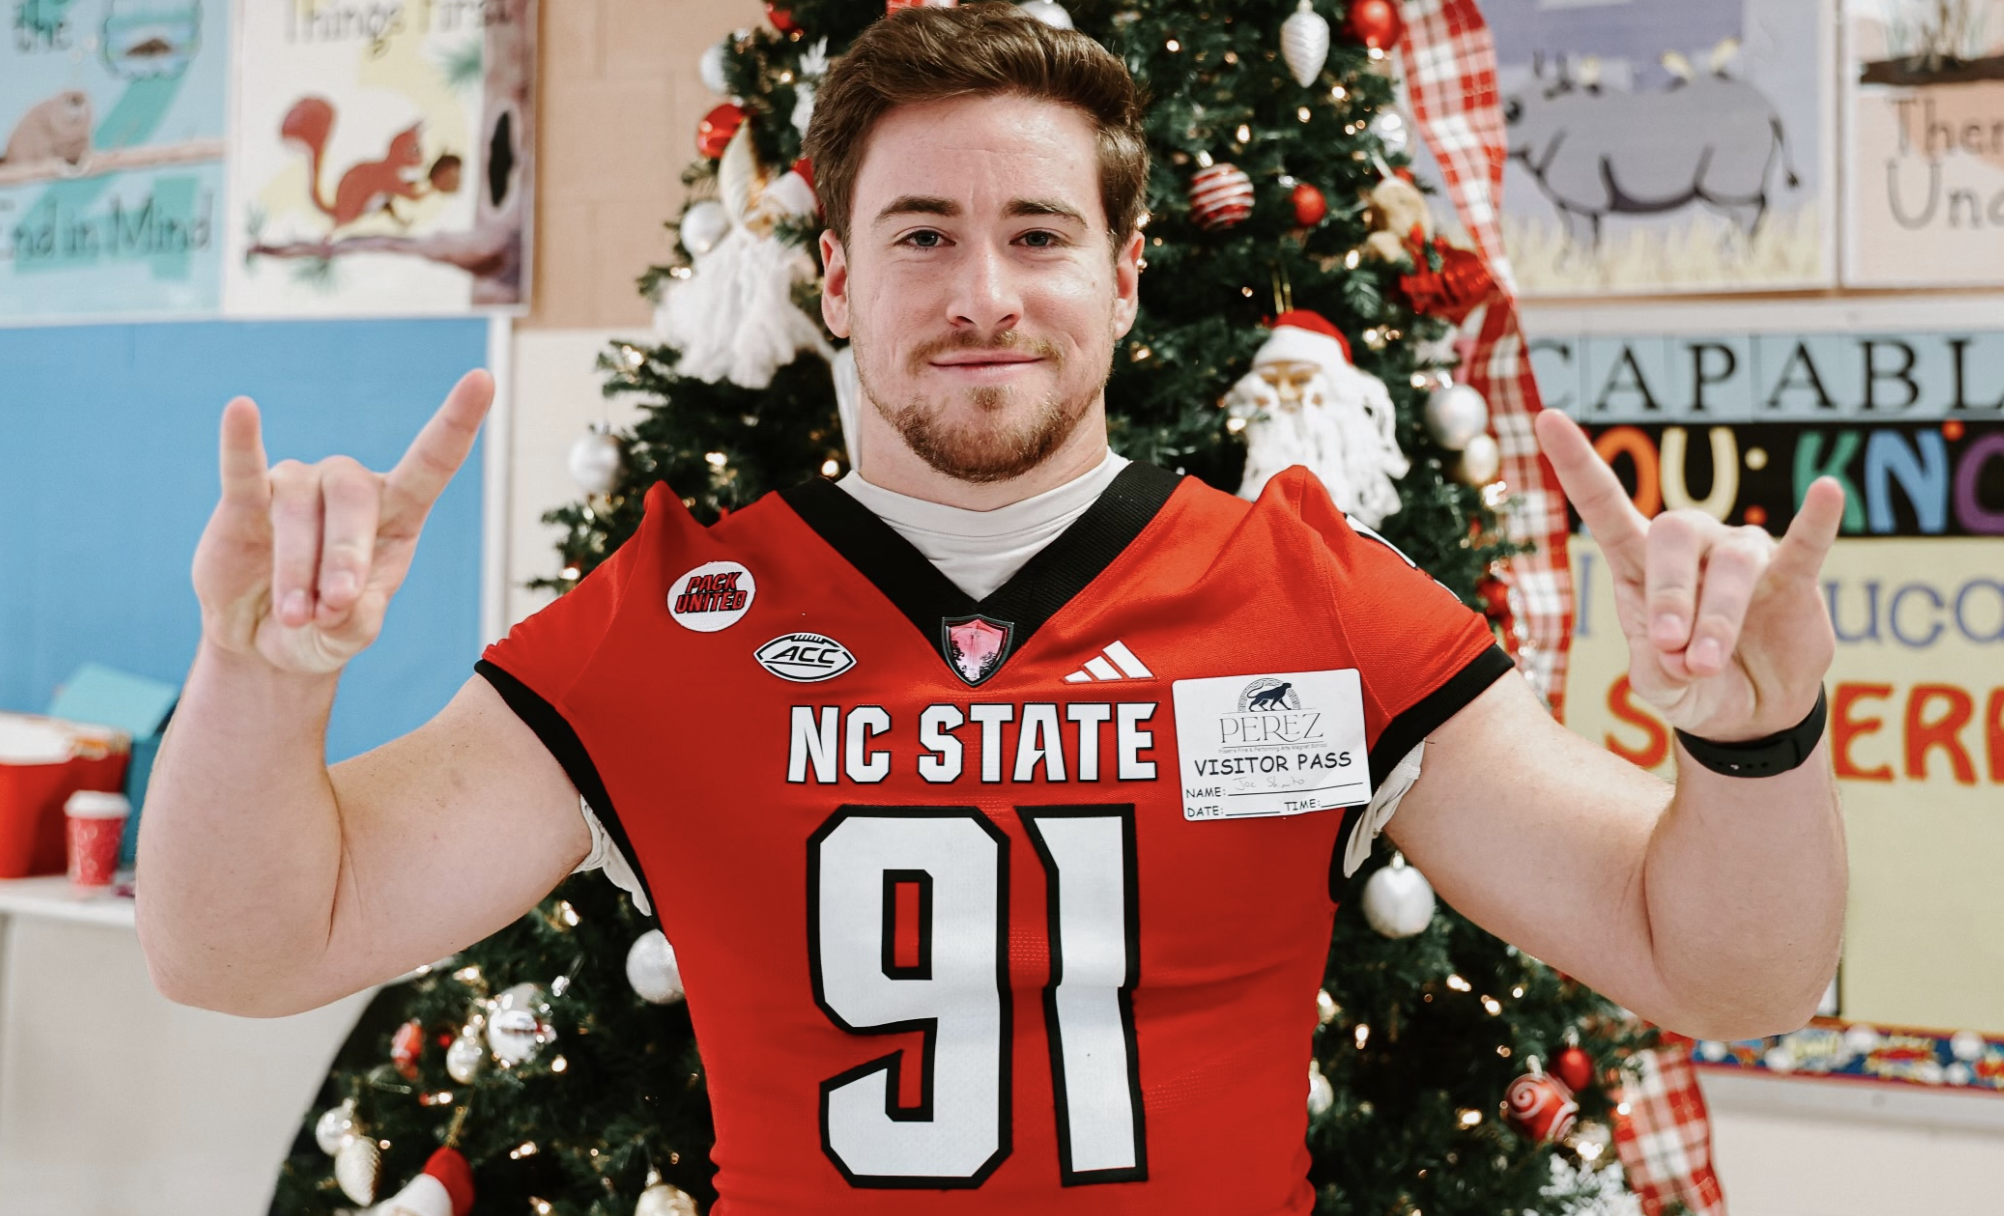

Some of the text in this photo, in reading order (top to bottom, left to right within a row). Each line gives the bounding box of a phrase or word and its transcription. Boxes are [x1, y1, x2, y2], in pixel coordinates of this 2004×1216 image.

[1586, 424, 1740, 524] OU
[685, 571, 743, 593] PACK
[674, 590, 748, 614] UNITED
[769, 645, 841, 665] ACC
[1219, 712, 1324, 743] PEREZ
[786, 701, 1159, 784] NC STATE
[1194, 751, 1352, 777] VISITOR PASS
[1186, 787, 1226, 799] NAME:
[1187, 798, 1321, 818] DATE: TIME:
[806, 803, 1149, 1189] 91
